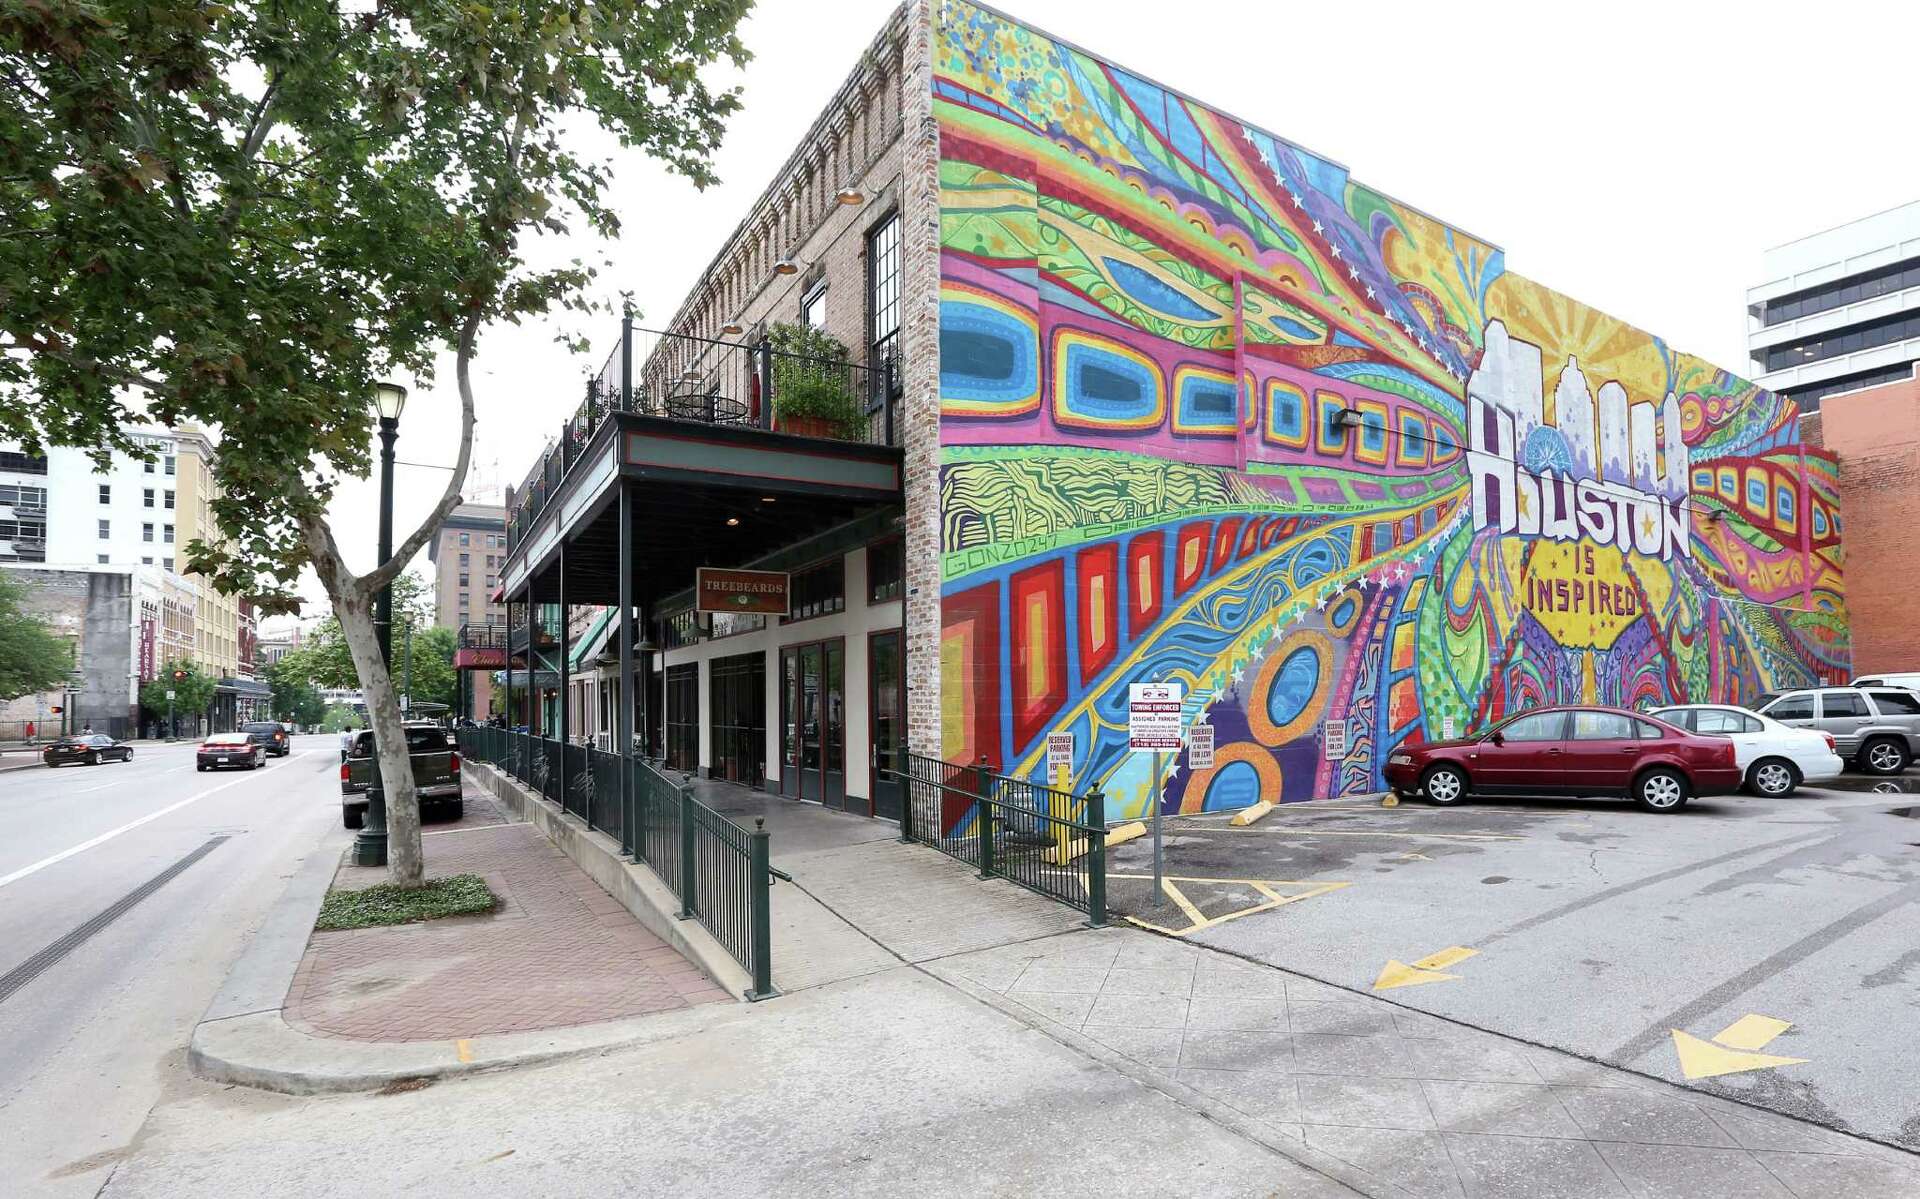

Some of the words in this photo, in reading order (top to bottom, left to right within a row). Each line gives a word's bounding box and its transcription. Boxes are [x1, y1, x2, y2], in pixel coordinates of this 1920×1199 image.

[1466, 395, 1692, 563] HOUSTON
[944, 533, 1059, 578] GONZO247
[1574, 545, 1597, 576] IS
[704, 580, 784, 594] TREEBEARDS
[1527, 577, 1637, 616] INSPIRED
[1131, 703, 1152, 711] TOWING
